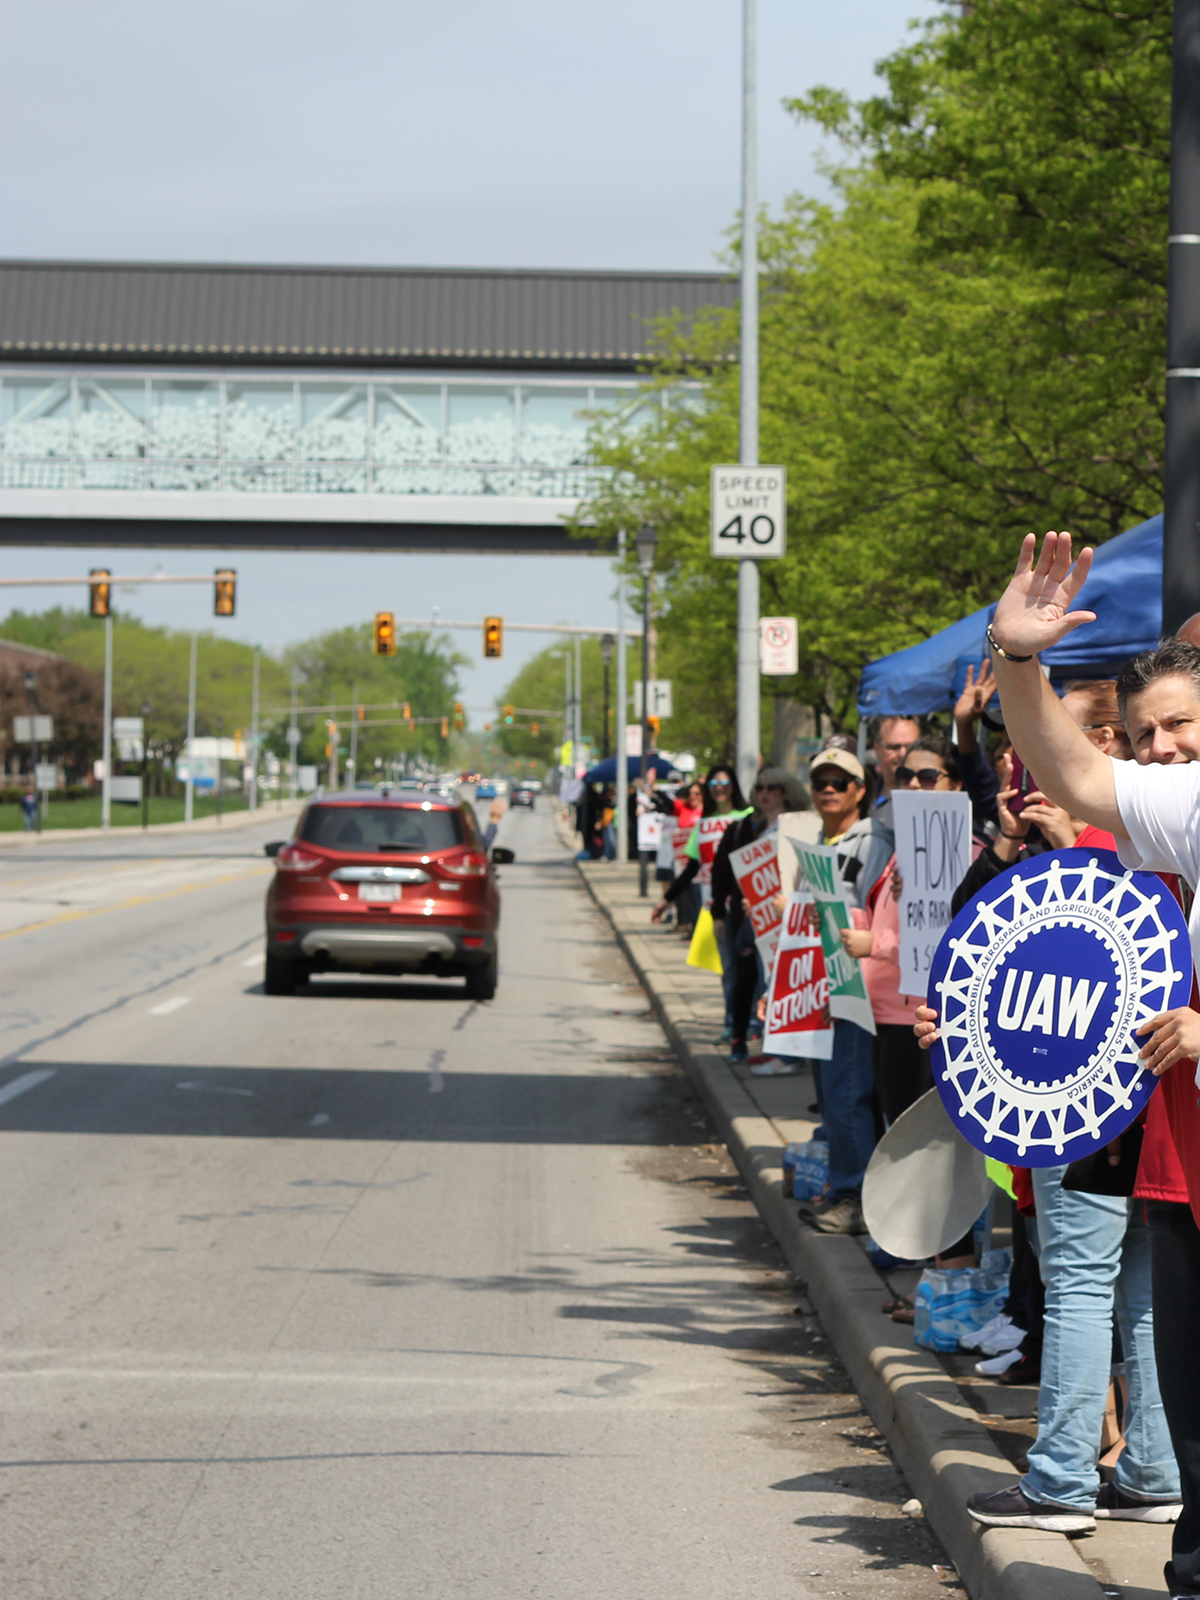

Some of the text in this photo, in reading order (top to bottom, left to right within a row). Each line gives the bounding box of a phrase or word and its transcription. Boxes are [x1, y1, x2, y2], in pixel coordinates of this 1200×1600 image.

[719, 476, 779, 491] SPEED
[725, 495, 769, 508] LIMIT
[718, 514, 775, 545] 40
[740, 840, 772, 865] UAW
[913, 809, 965, 891] HONK
[752, 862, 779, 897] ON
[788, 902, 821, 938] UA
[789, 950, 814, 989] ON
[769, 977, 830, 1032] STRIKE
[968, 904, 1138, 1099] UNITED AUTOMOBILE, AEROSPACE AND AGRICULTURAL IMPLEMENT WORKERS OF AMERICA
[997, 967, 1109, 1040] UAW
